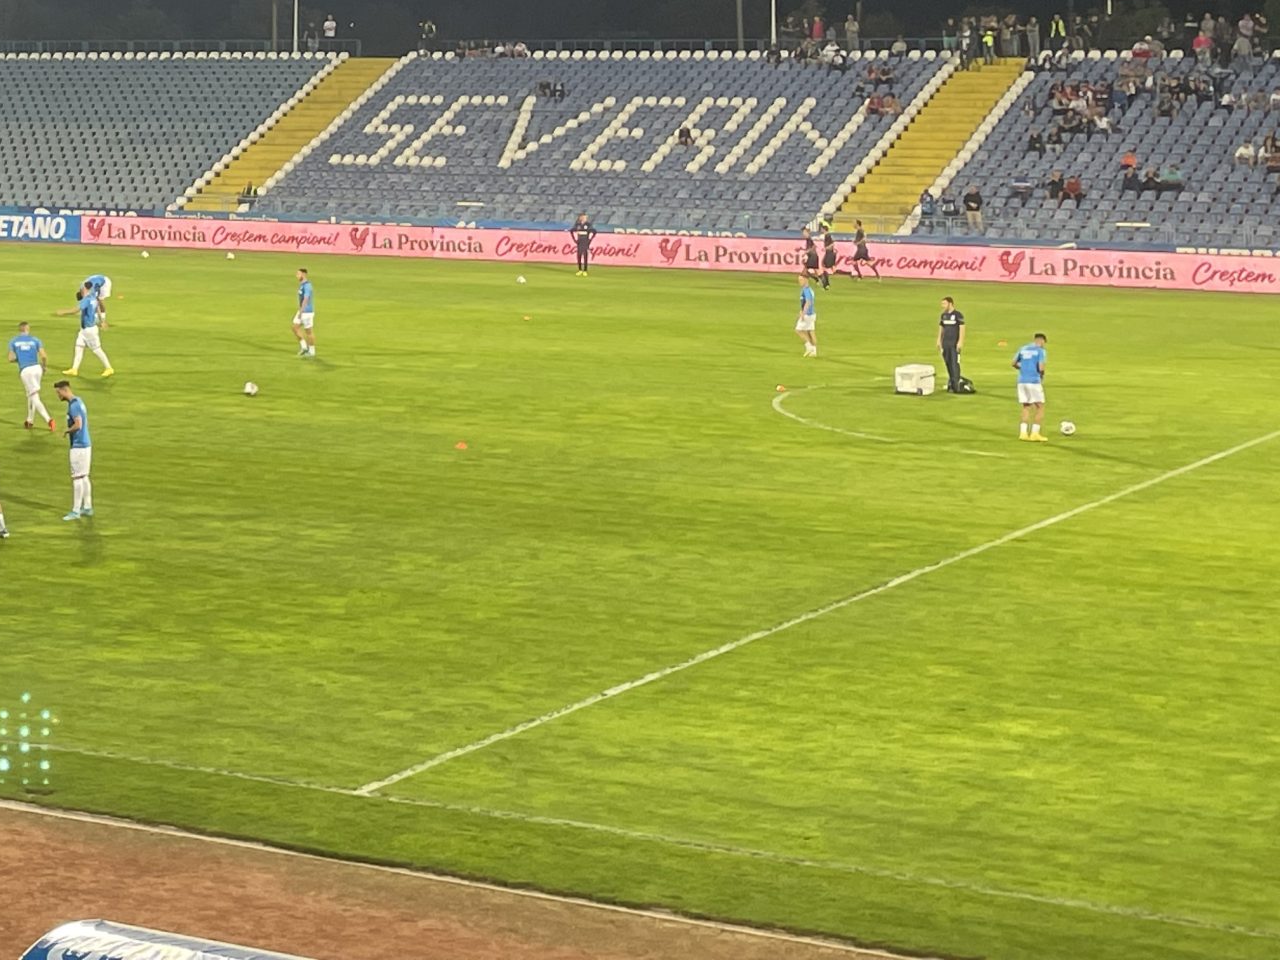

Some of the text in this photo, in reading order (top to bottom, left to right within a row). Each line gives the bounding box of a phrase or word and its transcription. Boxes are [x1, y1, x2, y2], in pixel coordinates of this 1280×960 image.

[328, 94, 870, 176] SEVERIN
[107, 225, 126, 239] La
[130, 222, 206, 243] Provincia
[371, 232, 392, 250] La
[397, 234, 483, 253] Provincia
[562, 243, 640, 261] capioni!
[684, 243, 708, 262] La
[897, 256, 986, 275] campioni!
[1028, 256, 1056, 276] La
[1063, 259, 1176, 281] Provincia
